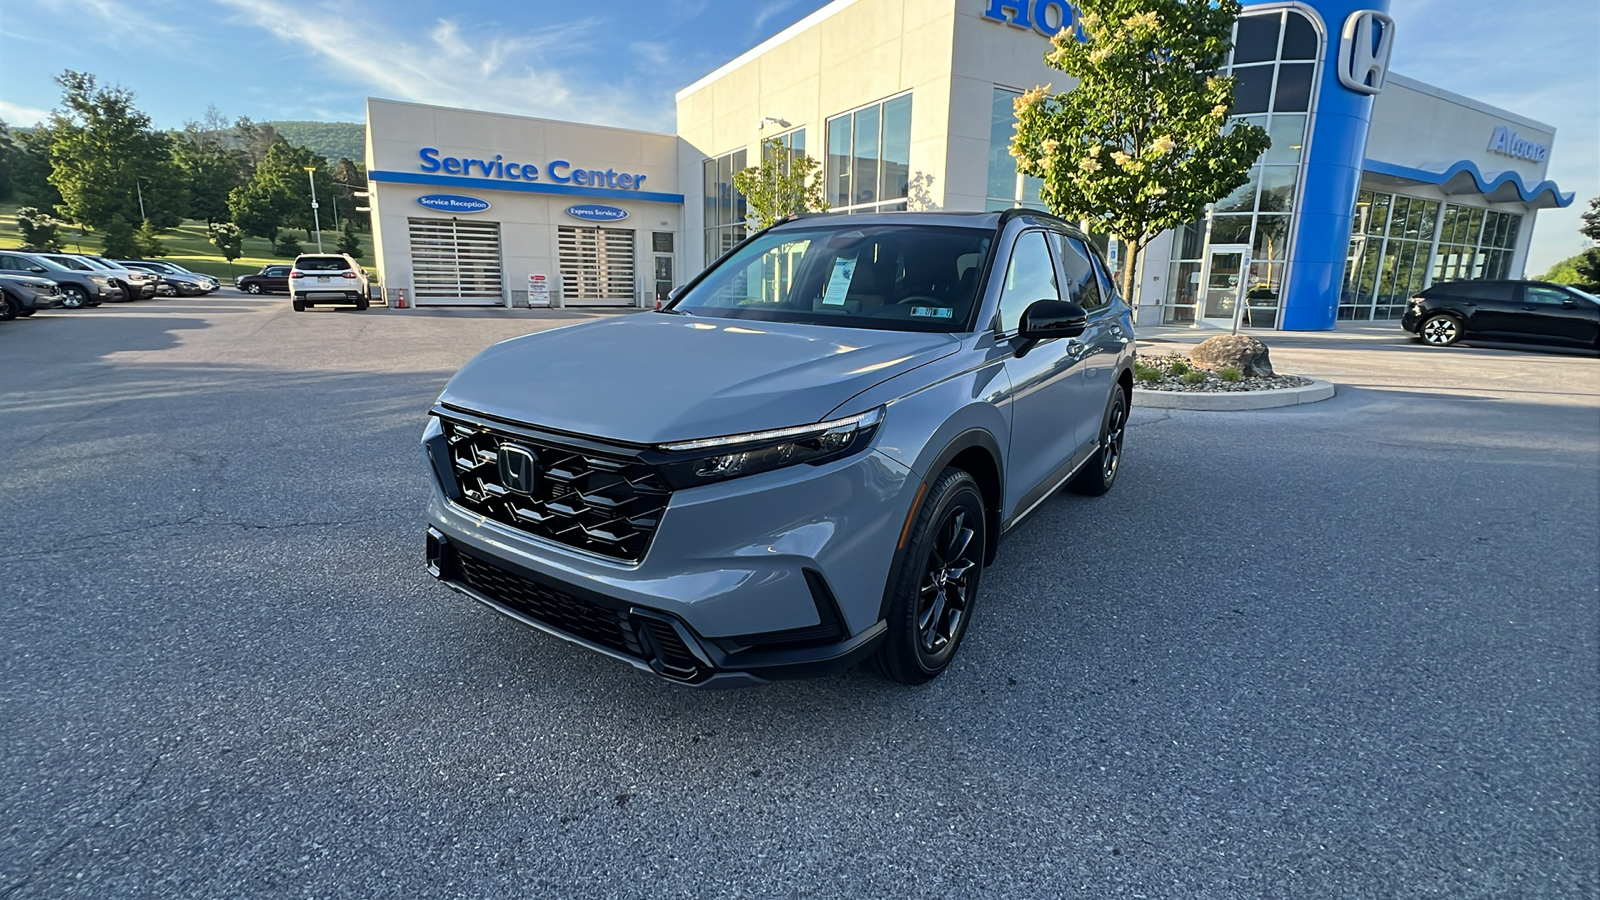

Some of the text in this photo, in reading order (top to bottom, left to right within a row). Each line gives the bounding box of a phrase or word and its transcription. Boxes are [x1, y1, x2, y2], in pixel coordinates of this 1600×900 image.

[419, 147, 647, 190] Service Center
[421, 197, 487, 209] Service Reception
[570, 207, 617, 217] Express Service
